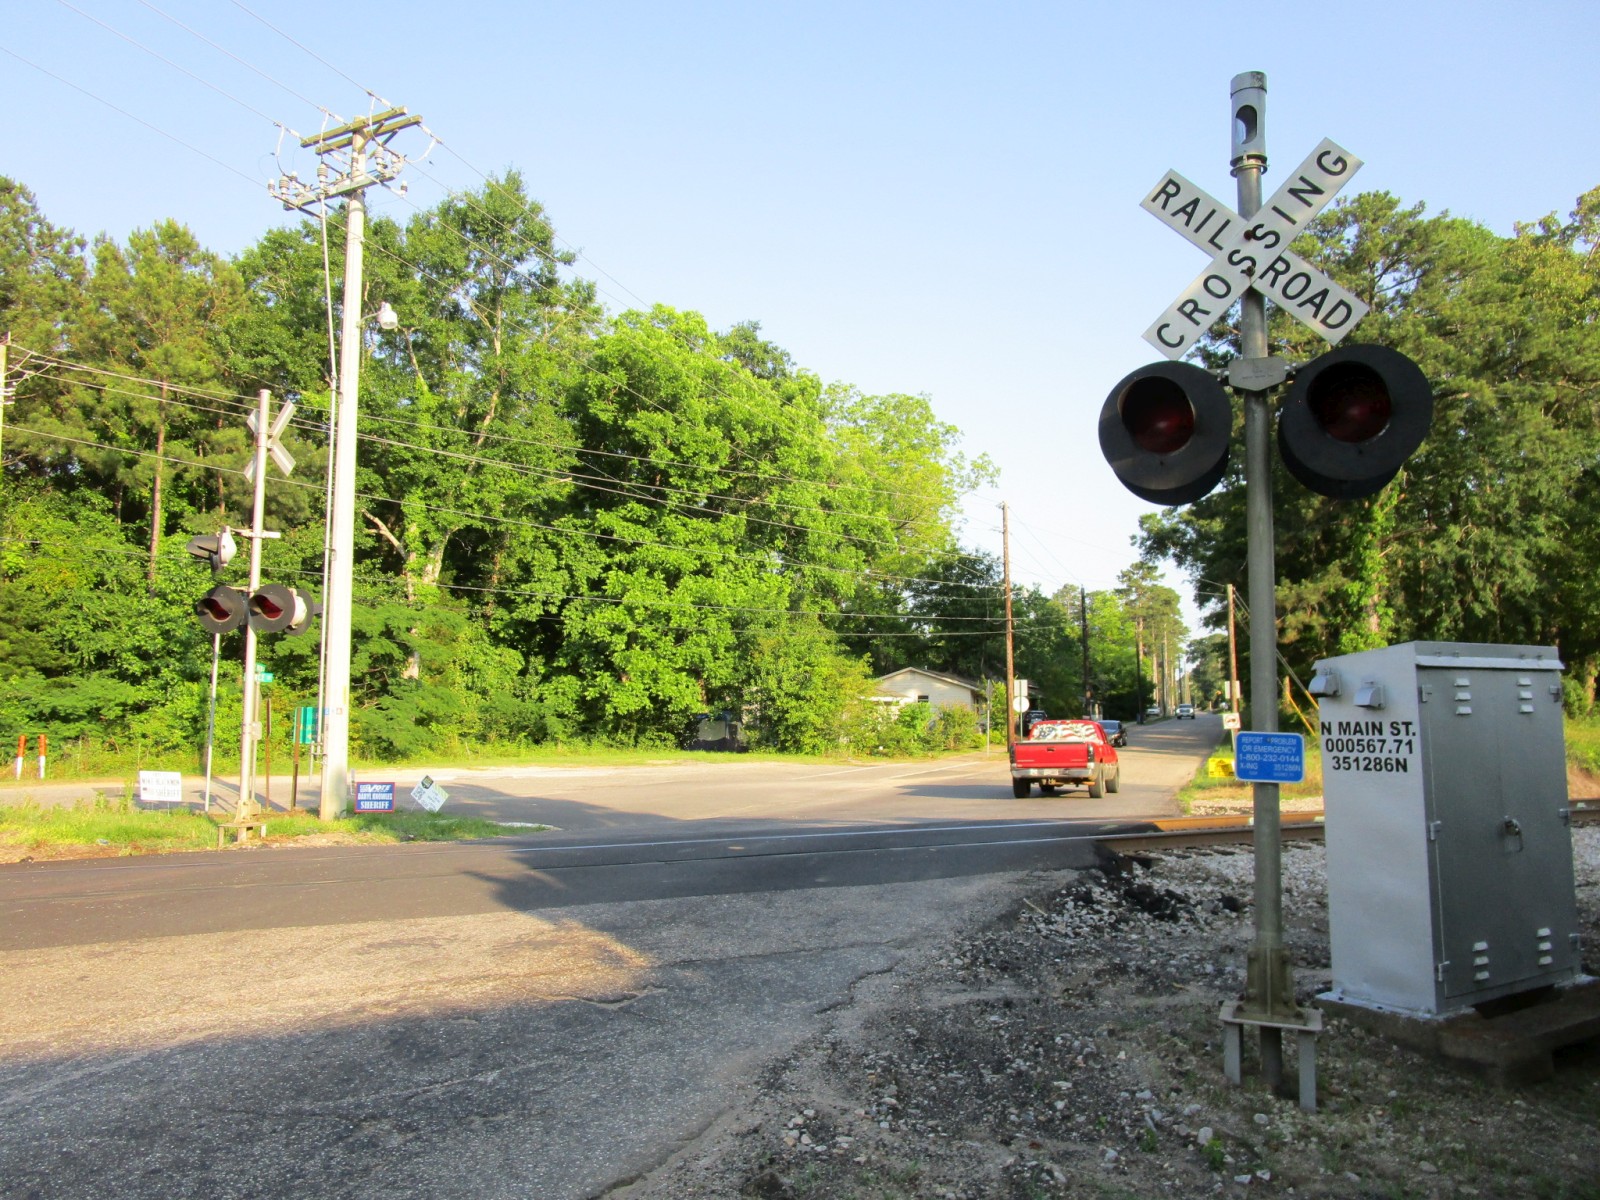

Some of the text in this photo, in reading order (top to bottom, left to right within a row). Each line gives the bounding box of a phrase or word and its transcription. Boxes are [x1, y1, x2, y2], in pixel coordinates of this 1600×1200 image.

[1151, 178, 1353, 330] RAIL ROAD
[1156, 149, 1348, 349] CROSSING
[1321, 721, 1416, 737] N MAIN ST.
[1241, 736, 1297, 745] REPORT PROBLEM
[1325, 738, 1413, 754] 000567.71
[1253, 745, 1297, 754] EMERGENCY
[1239, 753, 1300, 763] 1-800-232-0144
[1332, 756, 1408, 773] 351286N
[1240, 762, 1259, 770] X-ING
[360, 800, 389, 810] SHERIFF
